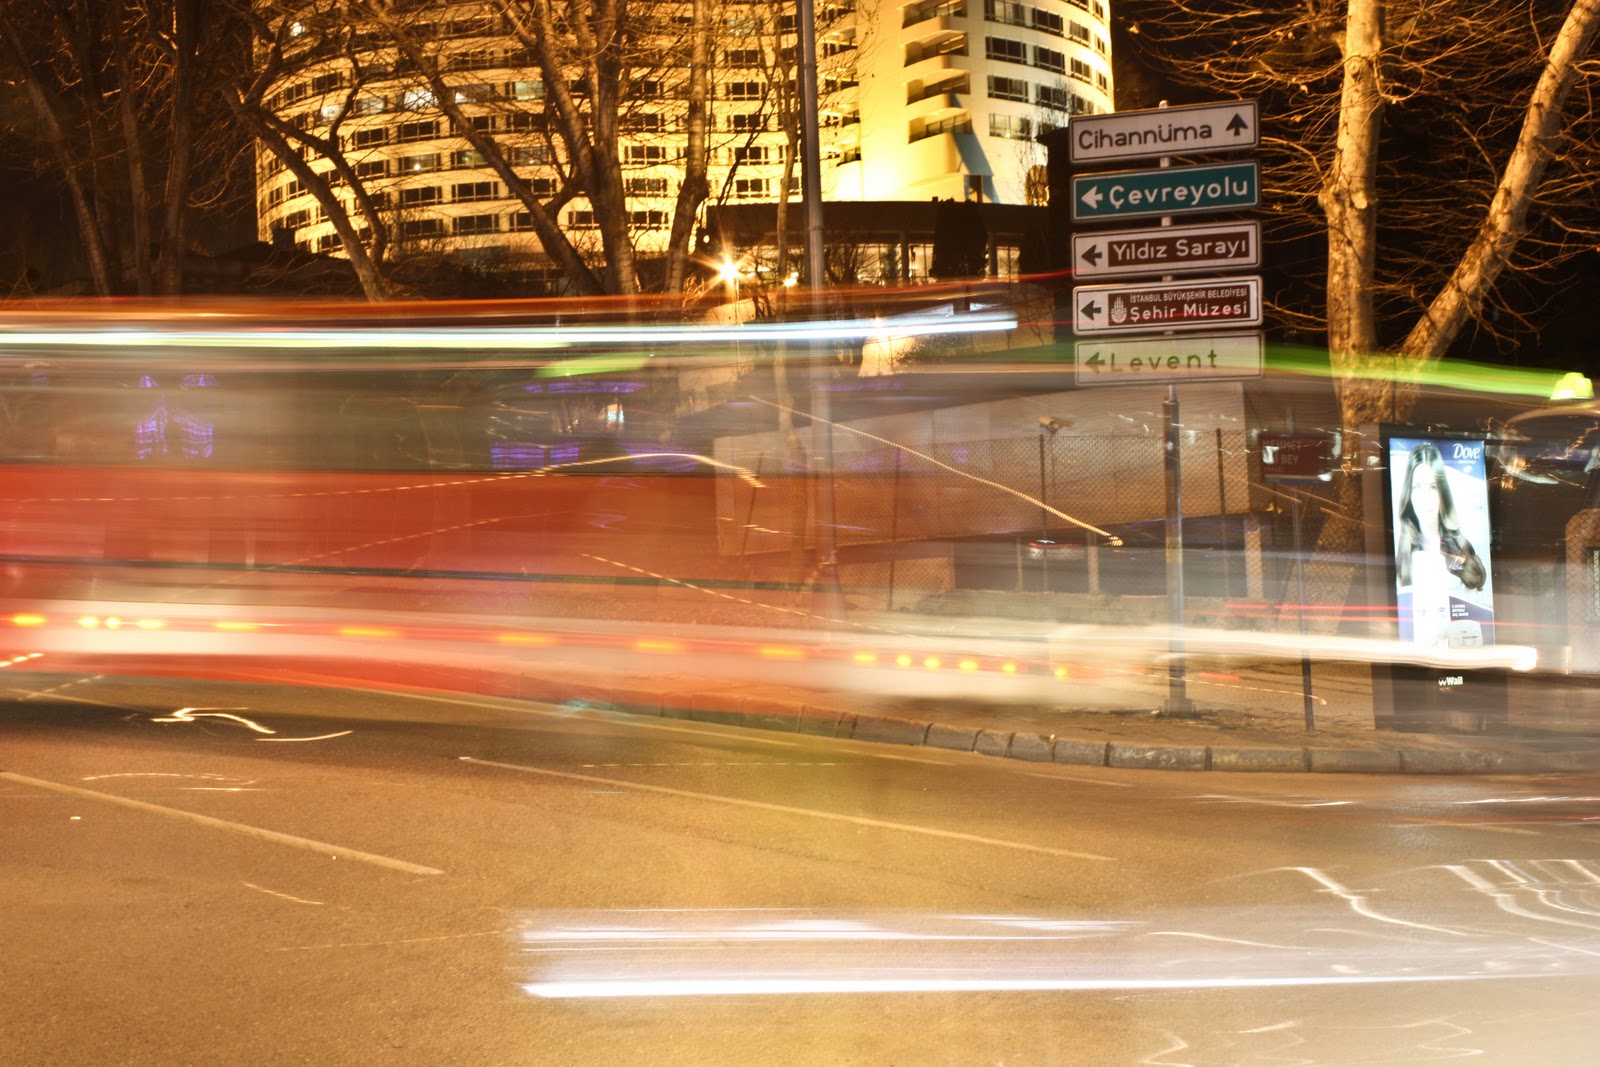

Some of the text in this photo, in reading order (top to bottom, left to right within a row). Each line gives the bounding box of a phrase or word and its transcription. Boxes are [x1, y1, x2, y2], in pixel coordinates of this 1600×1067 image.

[1078, 123, 1212, 149] Cihannüma
[1109, 176, 1248, 209] Çevreyolu
[1113, 239, 1246, 261] Yıldız Sarayı
[1130, 294, 1162, 303] İSTANBUL
[1207, 287, 1248, 299] BELEDİYESİ
[1130, 301, 1248, 322] Şehir Müzesi
[1111, 349, 1218, 373] Levent
[1281, 454, 1299, 465] BEY
[1452, 442, 1481, 460] Dove
